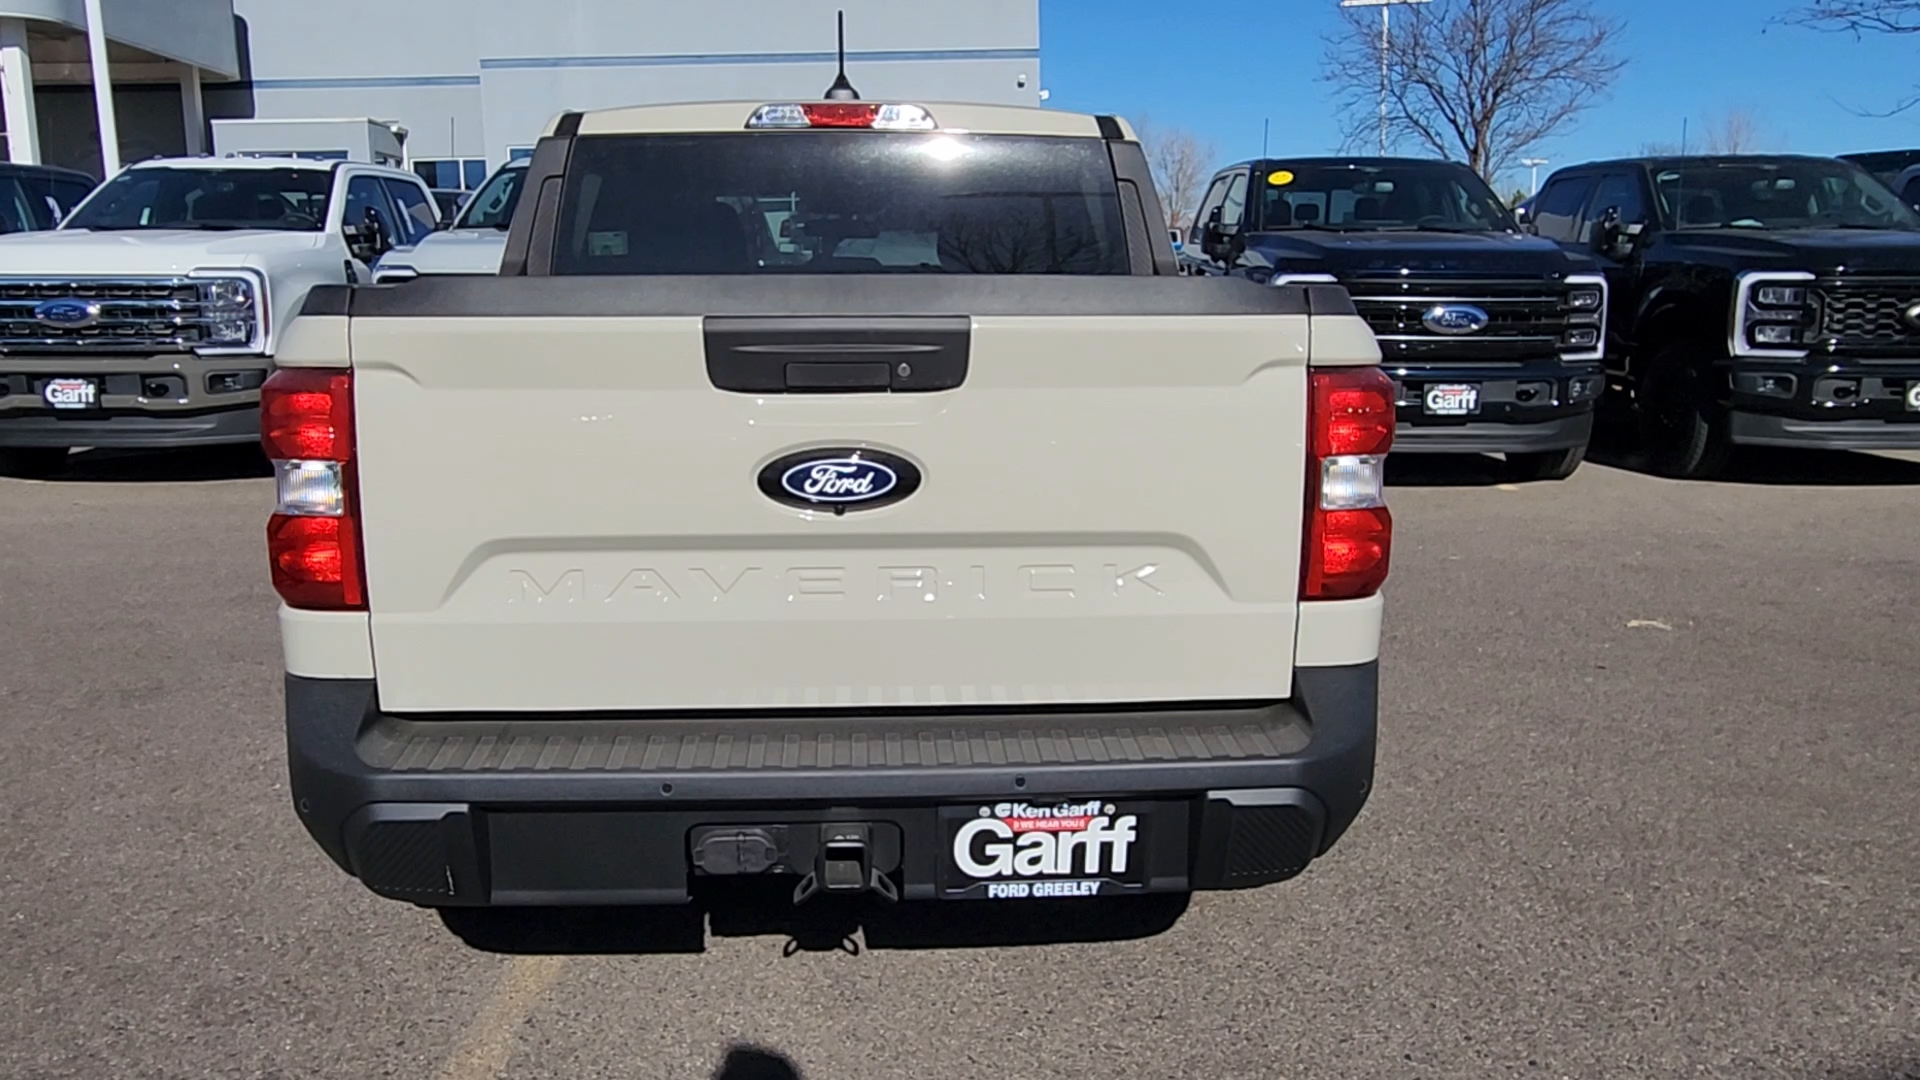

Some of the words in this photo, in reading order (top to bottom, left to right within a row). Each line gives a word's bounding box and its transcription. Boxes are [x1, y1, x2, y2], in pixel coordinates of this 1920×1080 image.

[45, 384, 95, 404] Garff
[1427, 389, 1477, 410] Garff
[803, 465, 875, 493] Ford
[508, 563, 1166, 602] MAVERICK
[1012, 803, 1051, 818] Ken
[1052, 800, 1102, 817] Garff
[1020, 820, 1035, 829] WE
[953, 815, 1138, 878] Garff
[988, 883, 1030, 899] FORD
[1032, 881, 1101, 897] GREELEY
